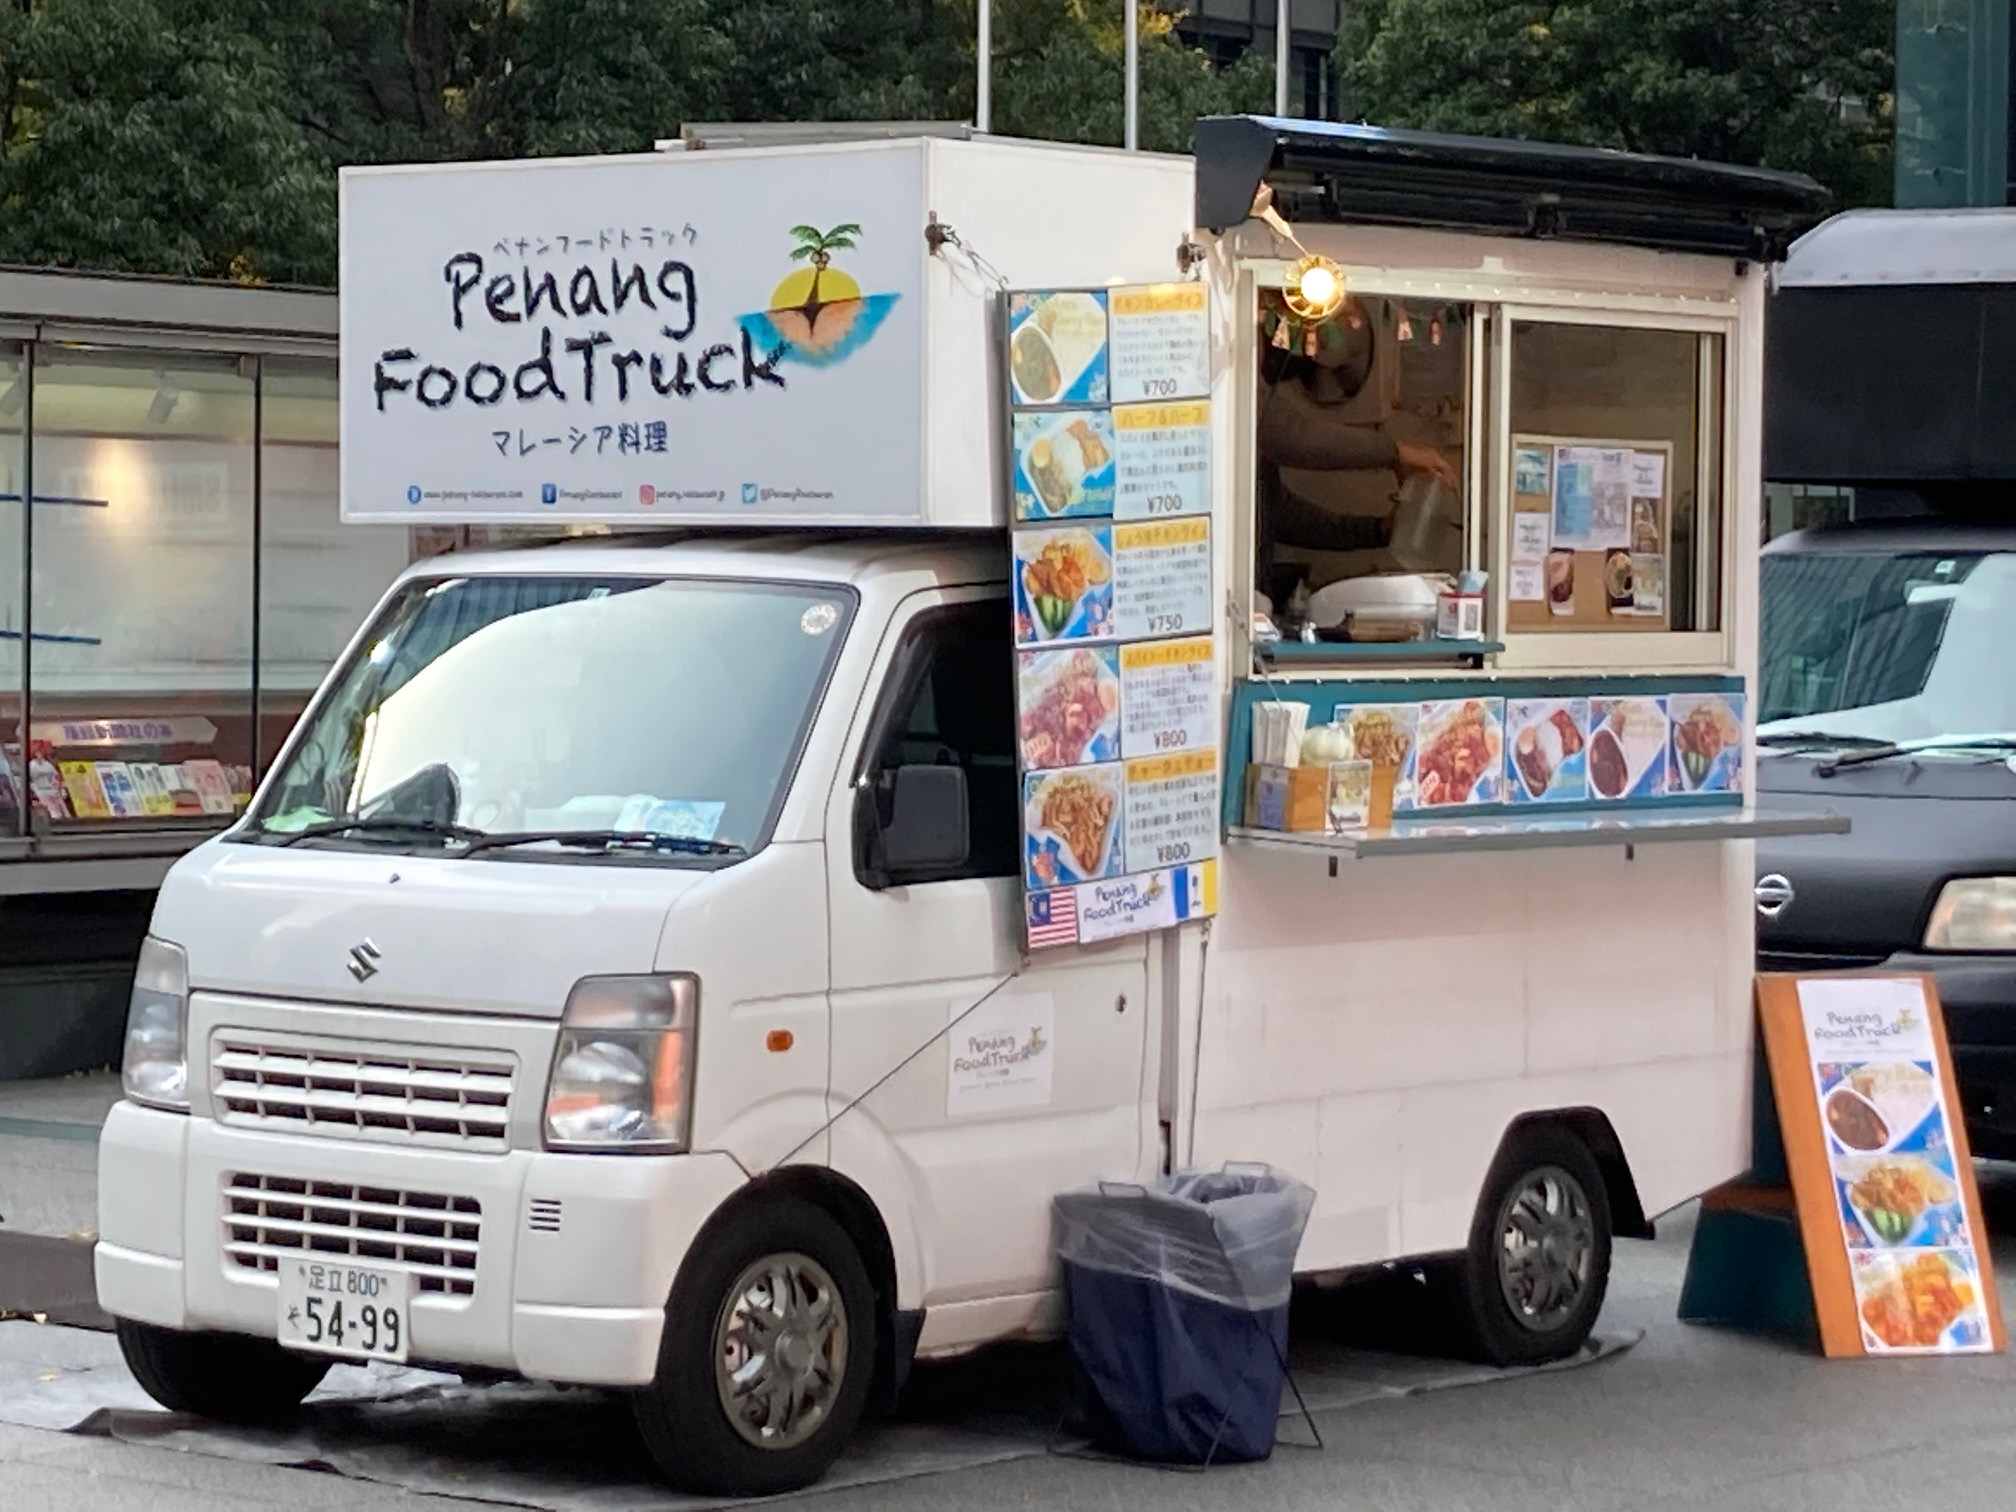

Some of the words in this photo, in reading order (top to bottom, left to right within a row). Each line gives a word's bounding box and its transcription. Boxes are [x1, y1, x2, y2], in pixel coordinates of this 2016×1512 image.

[444, 252, 698, 341] Penang
[374, 325, 792, 412] FoodTruck
[1143, 378, 1178, 396] ¥700
[492, 421, 669, 456] マレーシア料理
[1147, 493, 1182, 513] ¥700
[1153, 729, 1188, 749] ¥800
[1095, 883, 1138, 901] Penang
[1825, 1011, 1882, 1027] Penang
[968, 1036, 1015, 1053] Penang
[309, 1266, 344, 1292] 足立
[347, 1271, 379, 1296] 800
[306, 1297, 400, 1352] 54-99
